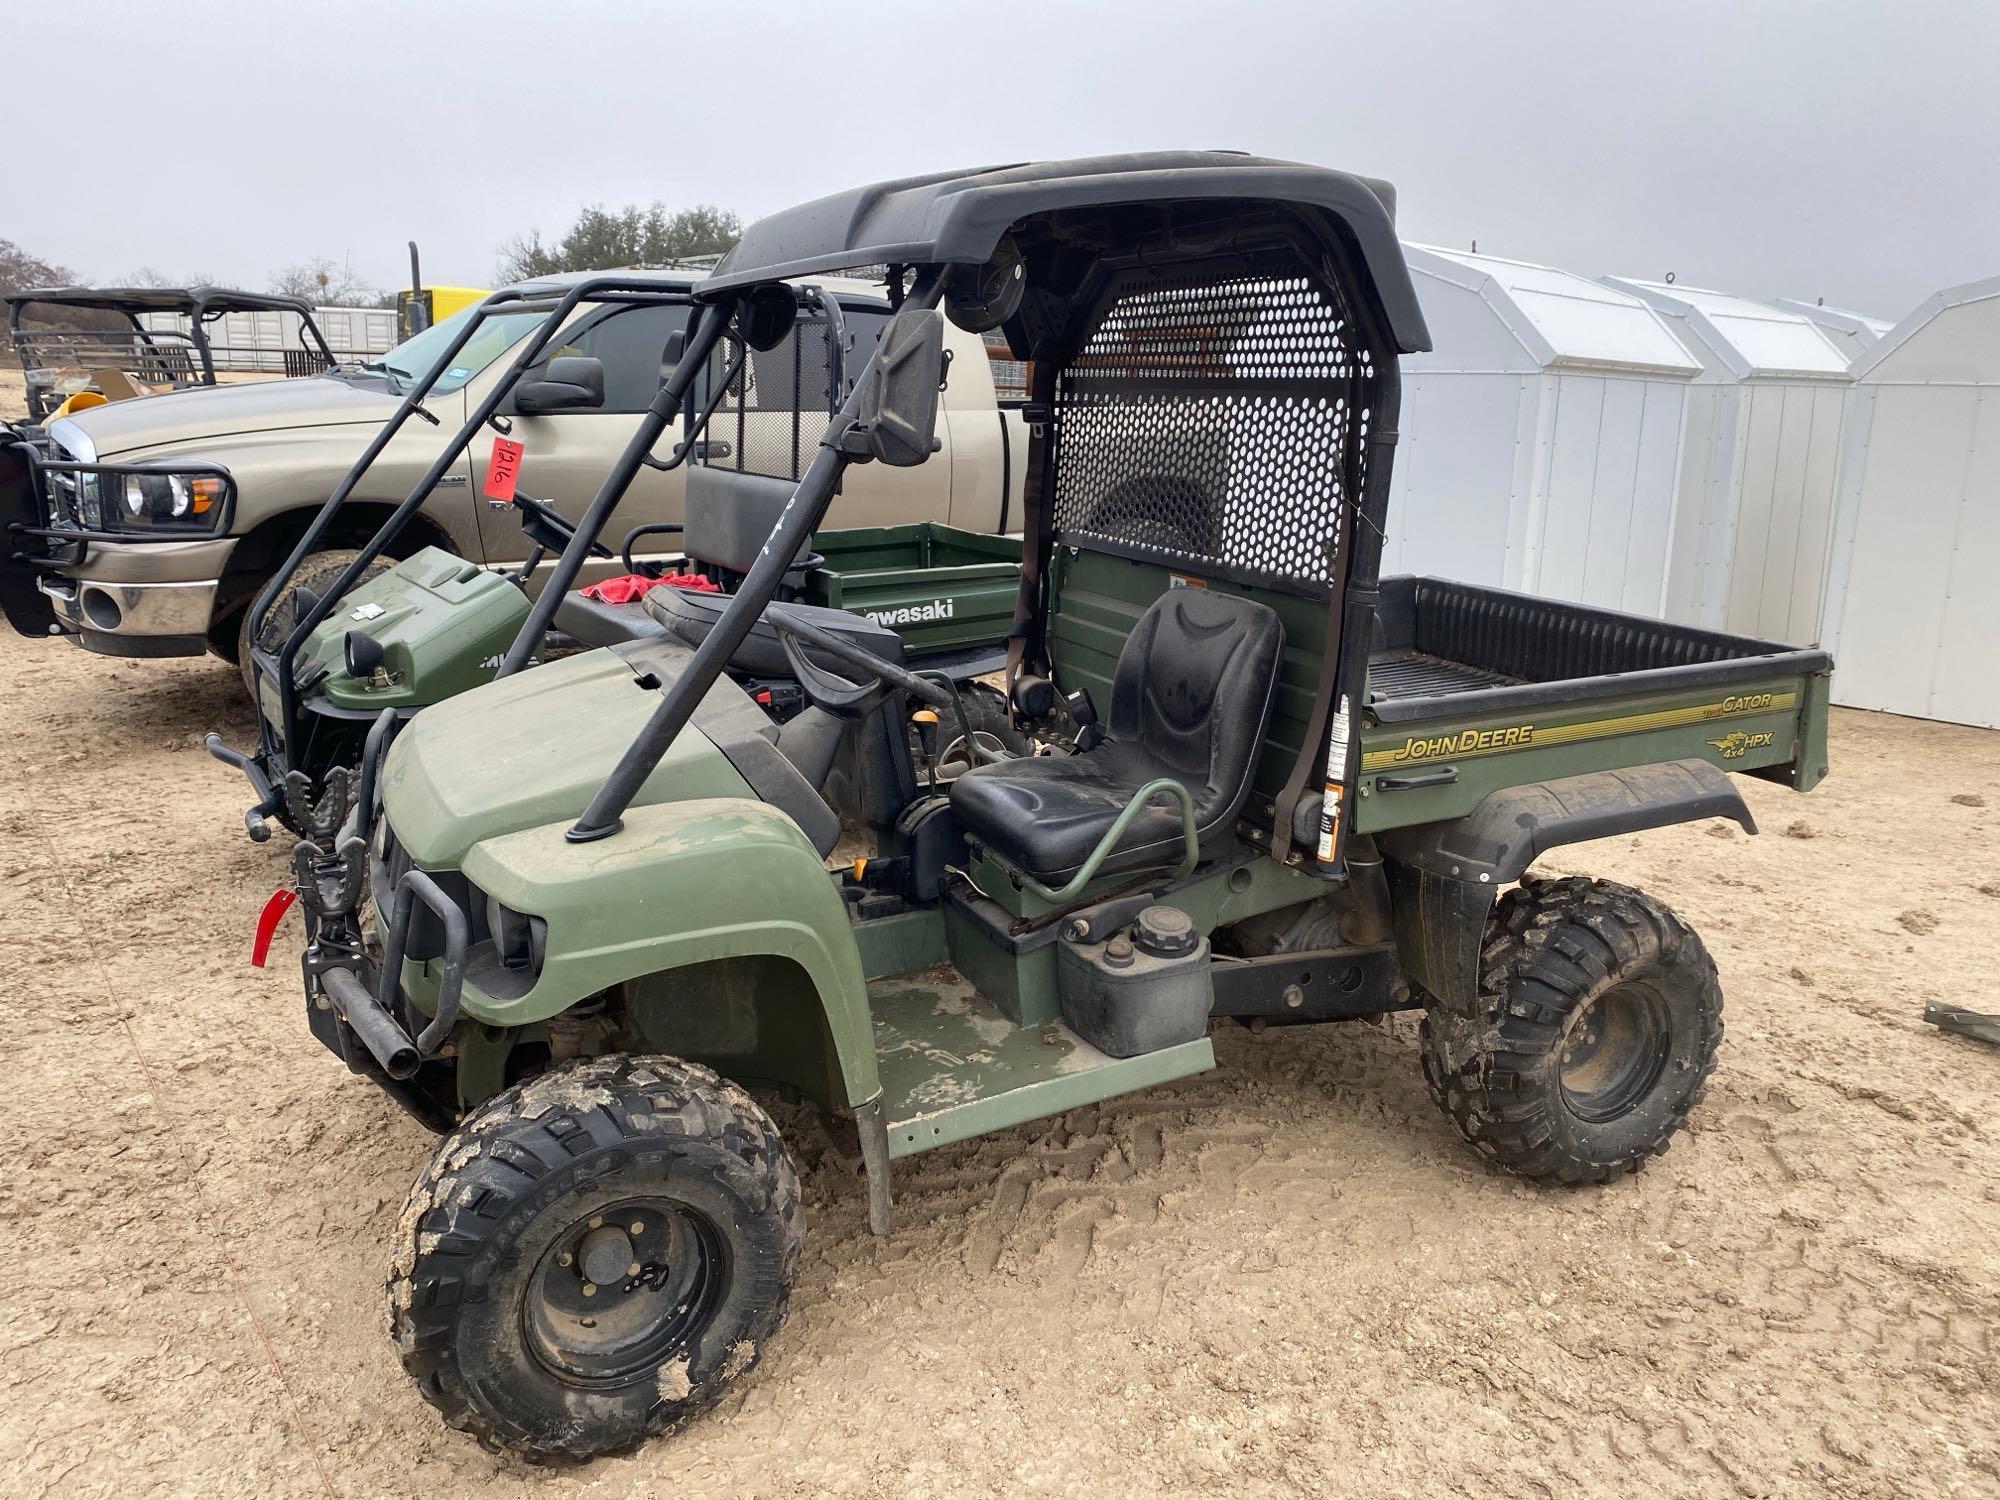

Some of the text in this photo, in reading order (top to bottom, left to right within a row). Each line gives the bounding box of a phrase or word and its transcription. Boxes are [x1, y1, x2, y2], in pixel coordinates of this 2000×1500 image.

[494, 447, 517, 484] 1216
[864, 598, 954, 626] awasaki
[1722, 693, 1772, 713] GATOR
[1394, 724, 1534, 761] JOHN DEERE
[1743, 731, 1775, 749] HPX
[1722, 746, 1745, 760] 4x4
